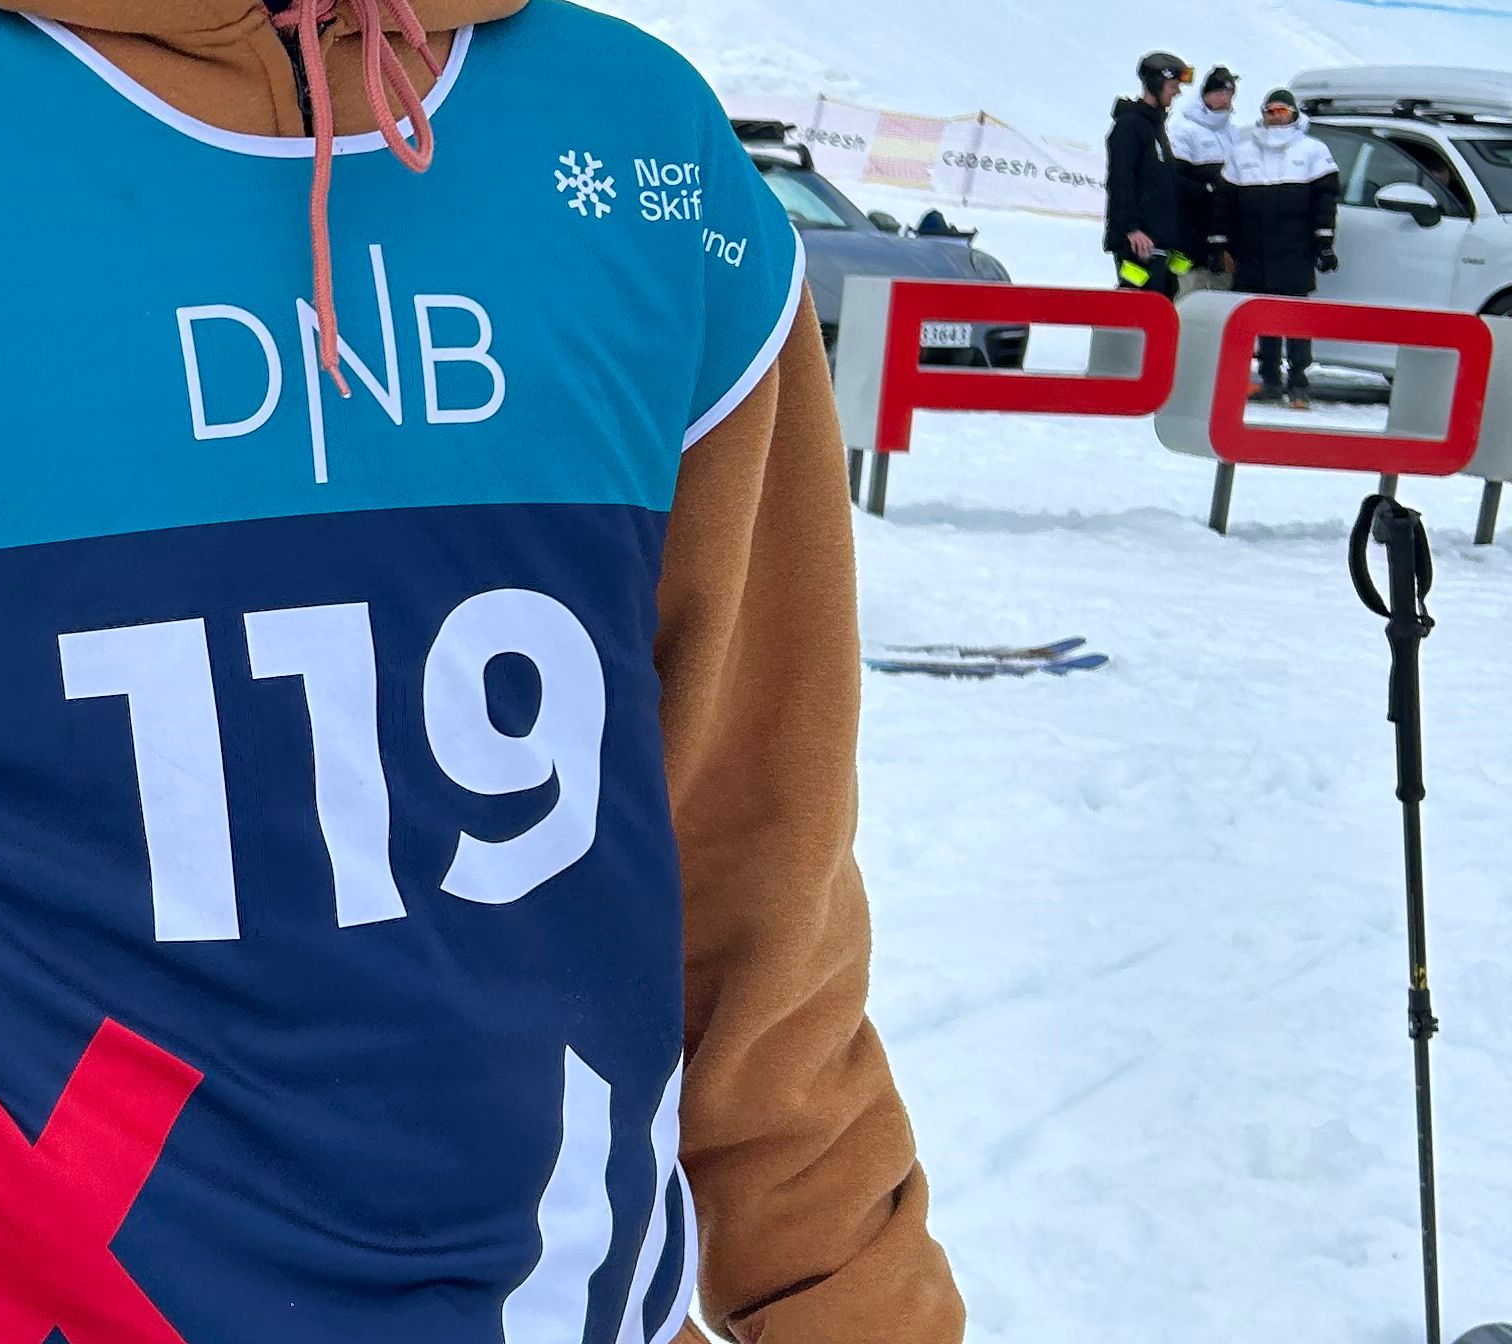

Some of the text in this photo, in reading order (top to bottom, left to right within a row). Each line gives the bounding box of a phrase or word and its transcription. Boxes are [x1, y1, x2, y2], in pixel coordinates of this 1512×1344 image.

[639, 188, 703, 222] Skif
[176, 244, 507, 484] DNB
[57, 586, 607, 943] 119
